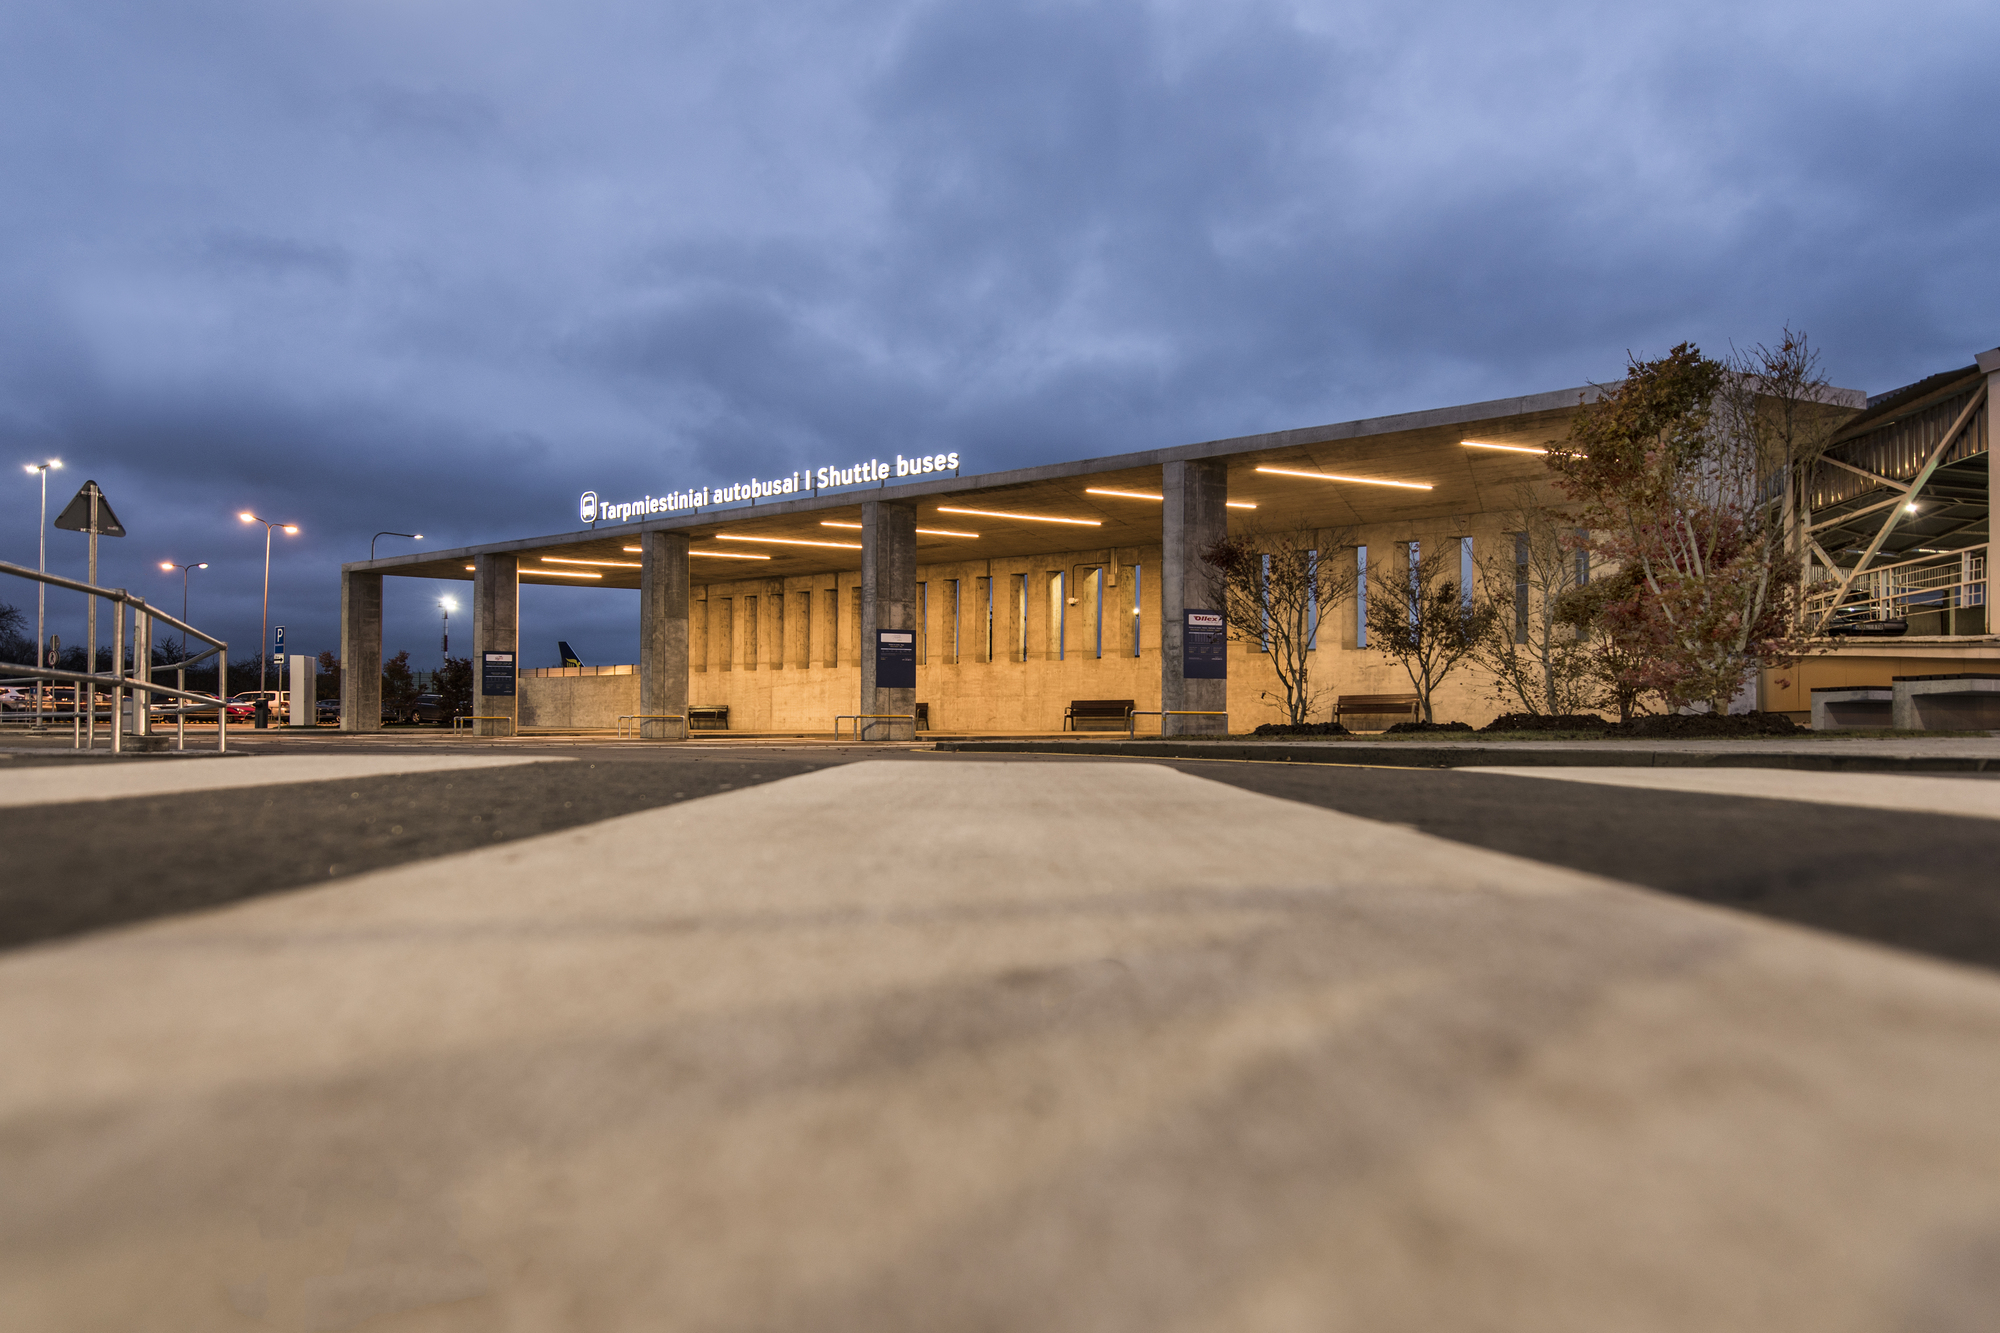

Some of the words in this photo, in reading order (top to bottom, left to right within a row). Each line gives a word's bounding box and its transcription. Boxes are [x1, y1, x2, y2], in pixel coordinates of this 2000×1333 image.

[599, 486, 709, 522] Tarpmiestiniai
[713, 471, 799, 504] autobusai
[817, 458, 890, 489] Shuttle
[896, 452, 960, 477] buses
[277, 628, 283, 642] P
